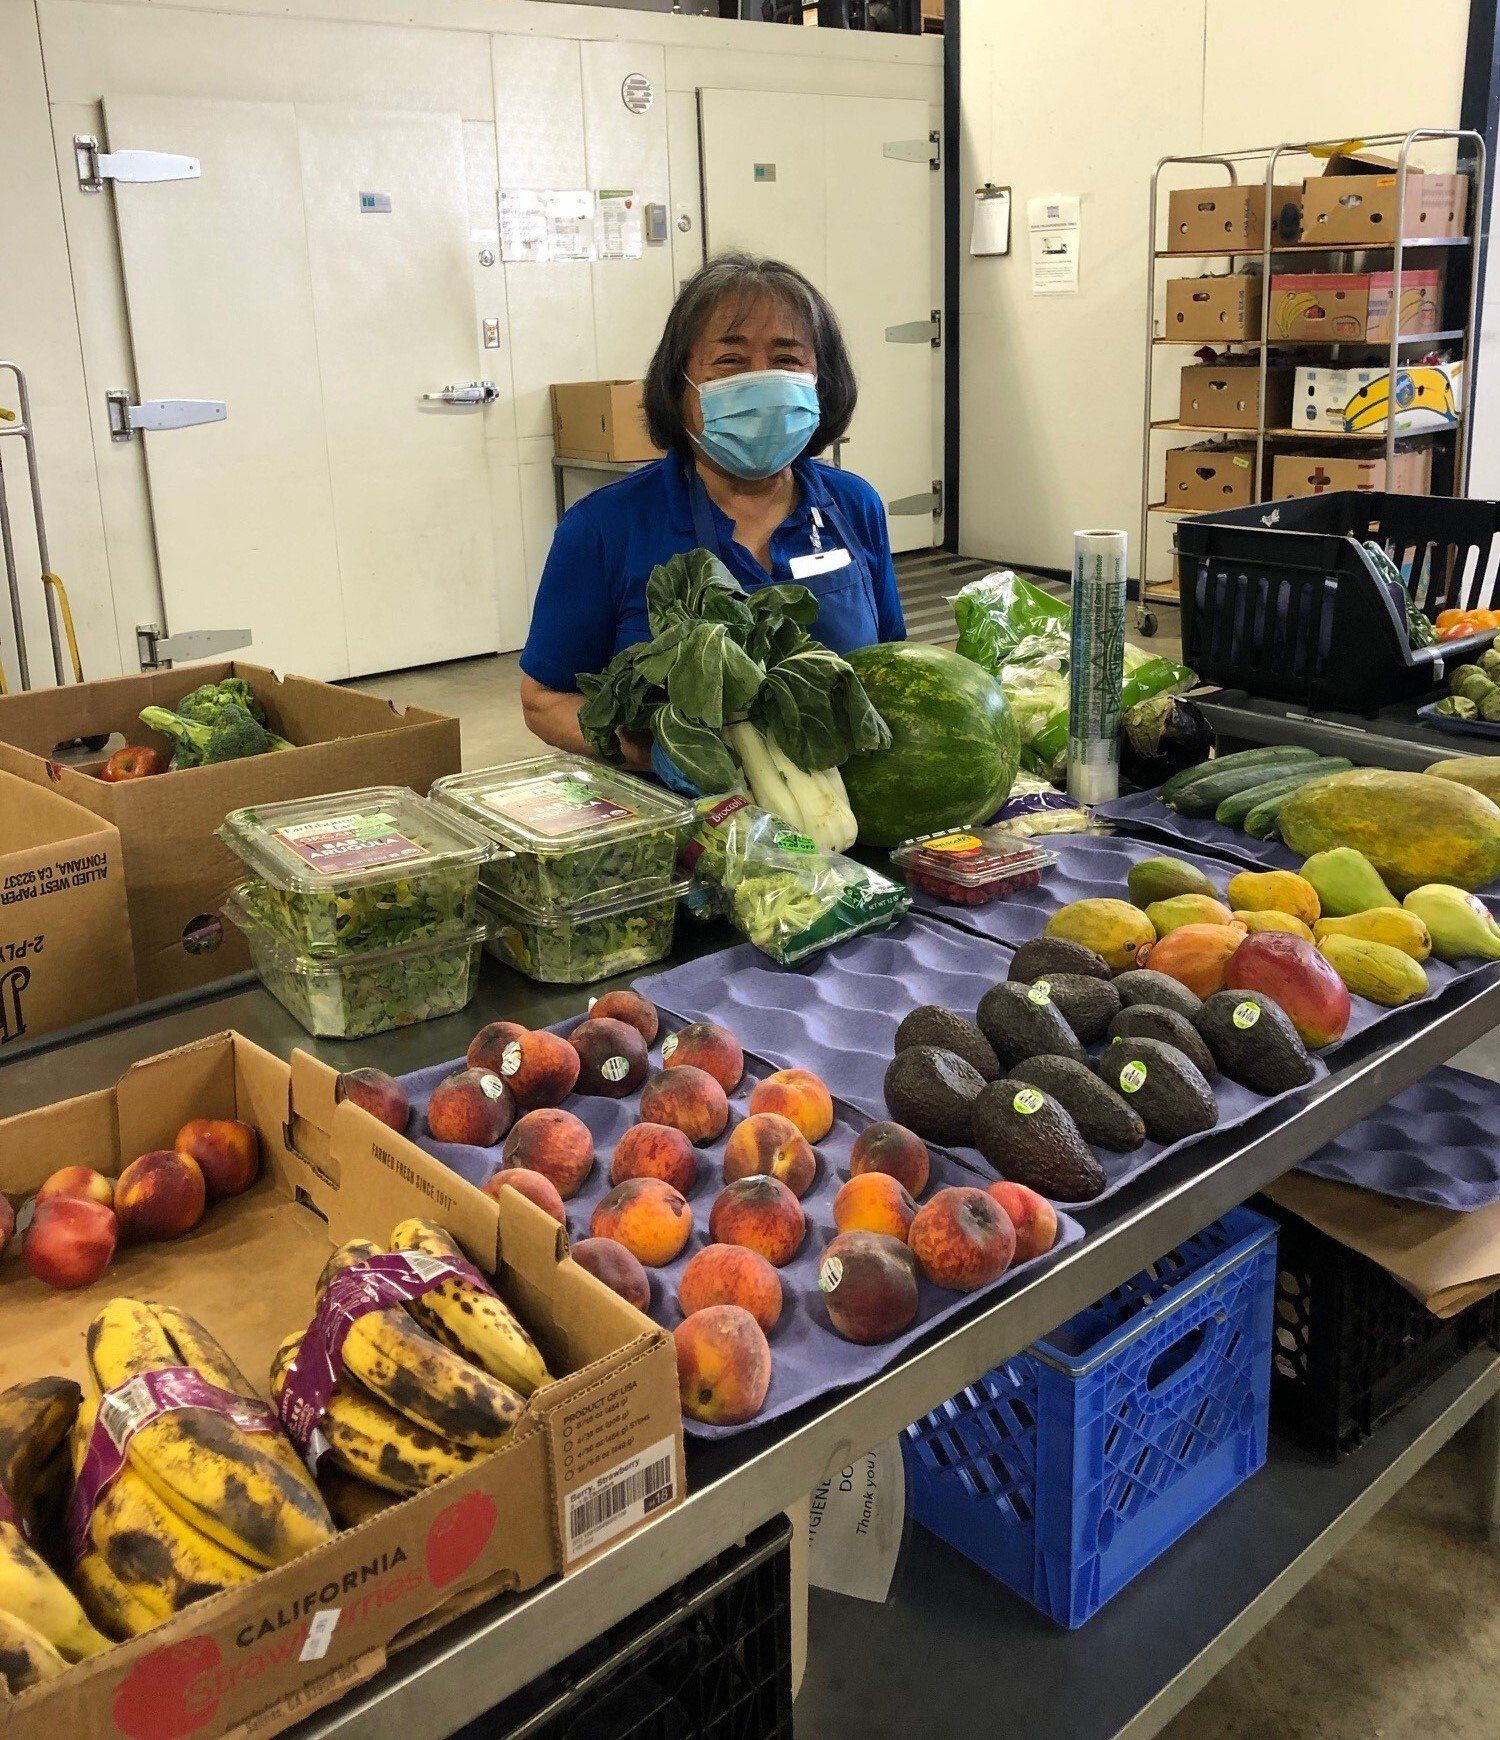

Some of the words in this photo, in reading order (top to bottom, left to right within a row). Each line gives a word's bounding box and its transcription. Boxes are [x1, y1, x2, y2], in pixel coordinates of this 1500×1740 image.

[310, 838, 399, 859] ARUGULA
[37, 866, 52, 880] CA
[56, 852, 107, 876] FONTANA,
[4, 871, 36, 890] 92337
[40, 876, 70, 896] WEST
[72, 866, 108, 887] ALLIED
[0, 885, 37, 905] PAPER
[372, 1142, 394, 1170] FARMED
[396, 1160, 414, 1185] FRESH
[416, 1174, 434, 1200] SINCE
[564, 1396, 604, 1426] PRODUCT
[607, 1390, 618, 1402] OF
[620, 1380, 638, 1395] USA
[570, 1486, 596, 1502] Berry,
[597, 1458, 640, 1486] Strawberry
[856, 1494, 875, 1536] Thank
[866, 1462, 877, 1488] you
[236, 1546, 408, 1648] CALIFORNIA
